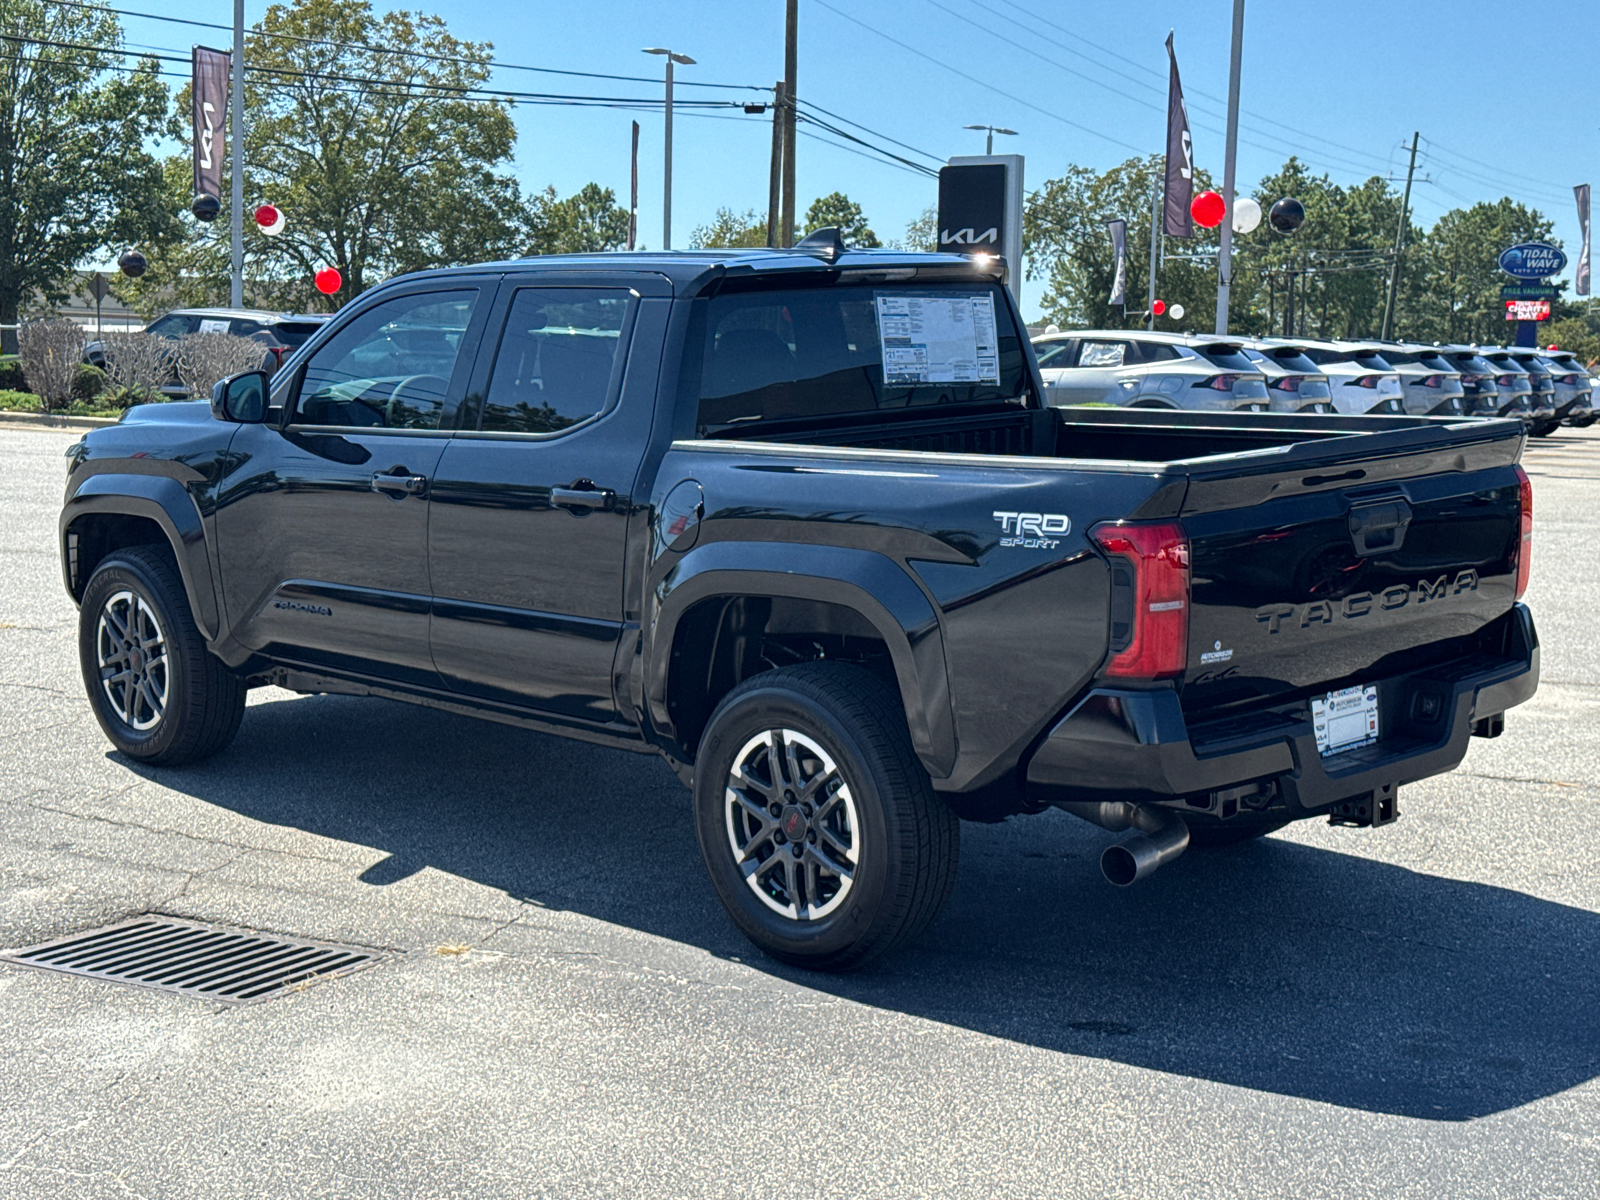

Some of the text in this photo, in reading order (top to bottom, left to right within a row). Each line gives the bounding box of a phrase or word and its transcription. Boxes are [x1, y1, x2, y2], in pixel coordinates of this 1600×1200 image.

[199, 102, 215, 170] KIA
[941, 227, 998, 245] KIA
[1522, 249, 1554, 259] TIDAL
[1526, 258, 1560, 268] WAVE
[1503, 287, 1554, 295] FREE VACUUMS
[992, 511, 1072, 537] TRD
[999, 537, 1060, 550] SPORT
[84, 569, 122, 606] GENERAL
[1254, 568, 1479, 635] TACOMA
[786, 812, 799, 834] TRD
